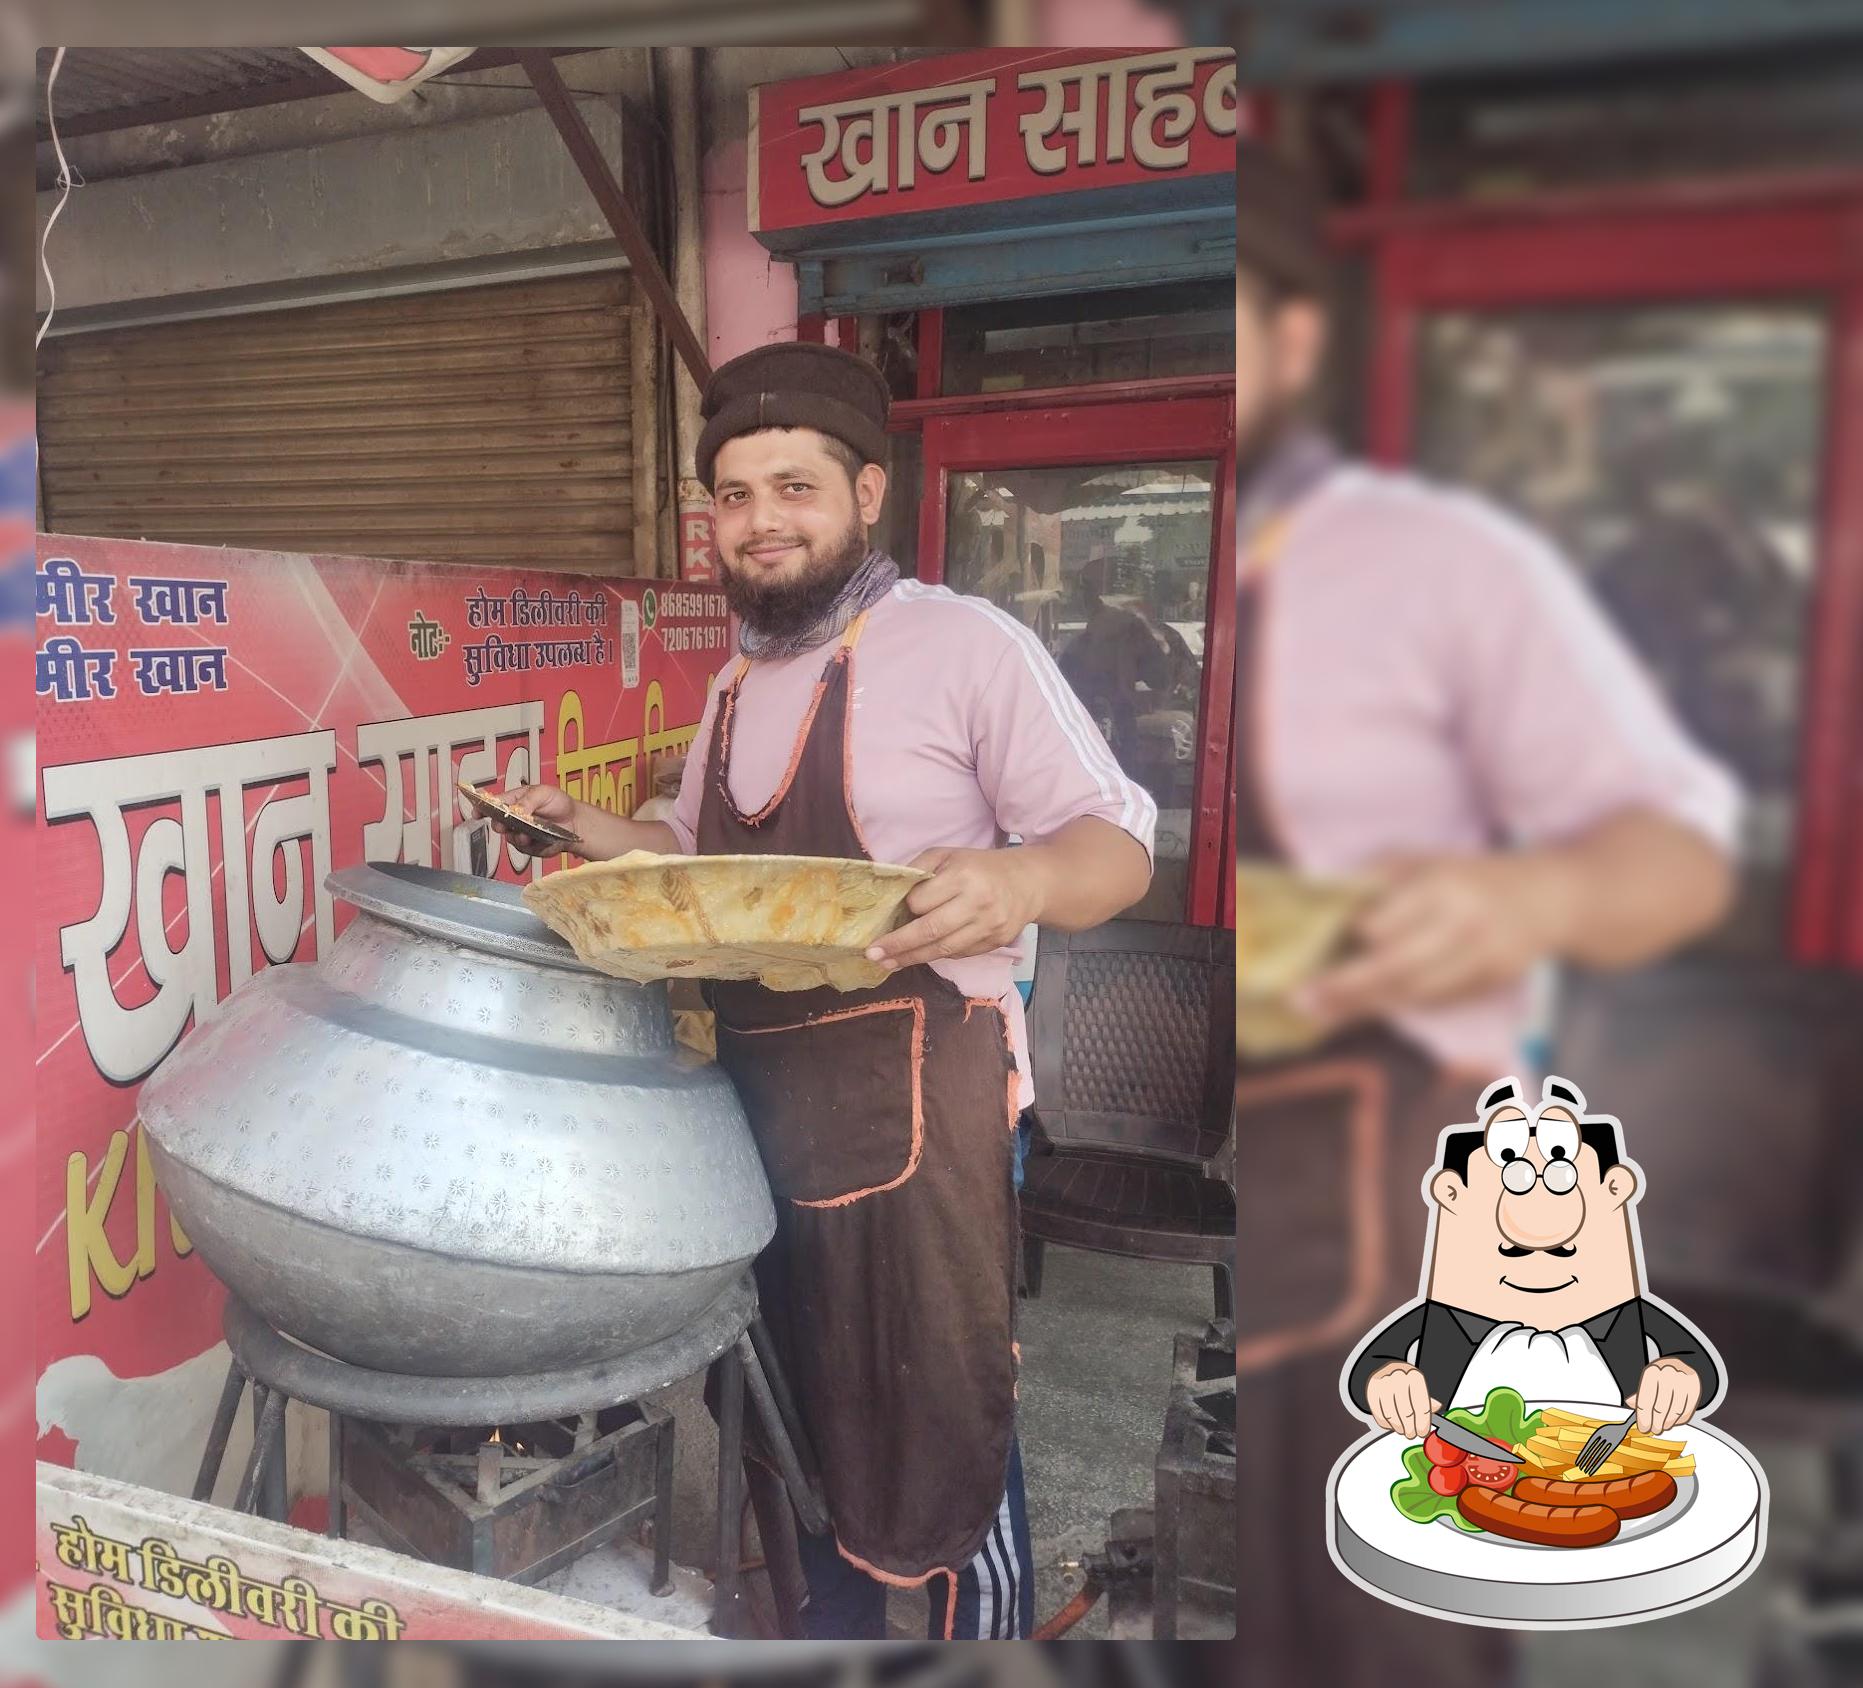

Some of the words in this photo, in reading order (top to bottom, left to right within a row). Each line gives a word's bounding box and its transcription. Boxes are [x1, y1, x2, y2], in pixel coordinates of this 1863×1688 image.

[799, 79, 995, 207] खान
[128, 577, 228, 625] खान
[465, 586, 507, 629] होम
[583, 592, 608, 626] की
[661, 593, 727, 617] 8685991678
[462, 634, 531, 686] सुविधा
[661, 627, 727, 652] 7206761971
[128, 647, 228, 697] खान
[42, 729, 336, 1084] खान
[51, 1515, 133, 1584] होम
[133, 1538, 322, 1638] डिलीवरी
